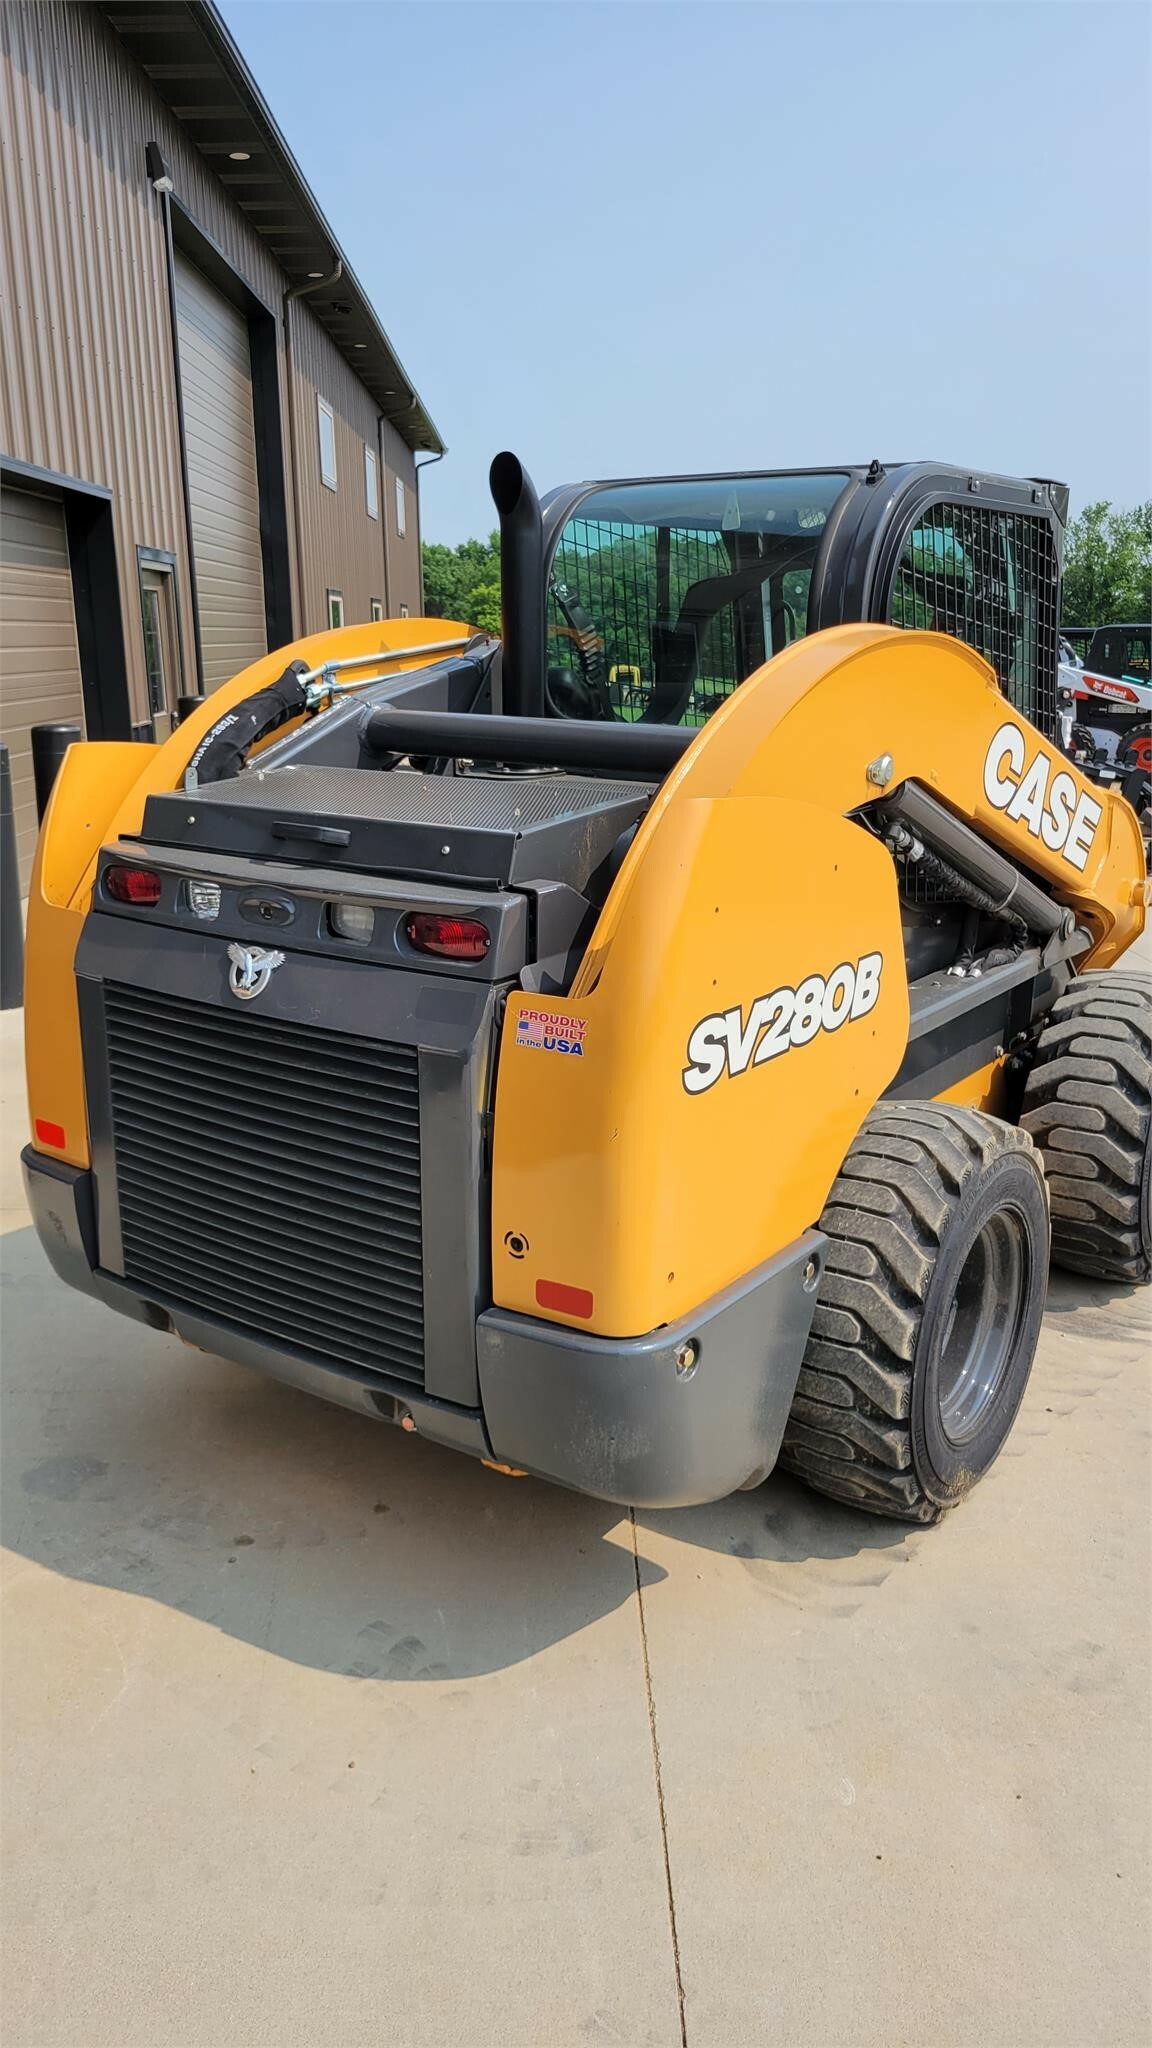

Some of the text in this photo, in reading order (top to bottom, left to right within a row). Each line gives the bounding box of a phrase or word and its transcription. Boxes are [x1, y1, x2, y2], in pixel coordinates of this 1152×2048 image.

[984, 722, 1103, 872] CASE
[520, 1009, 586, 1029] PROUDLY
[682, 951, 883, 1095] SV280B
[545, 1025, 586, 1040] BUILT
[527, 1039, 541, 1048] the
[544, 1037, 583, 1055] USA
